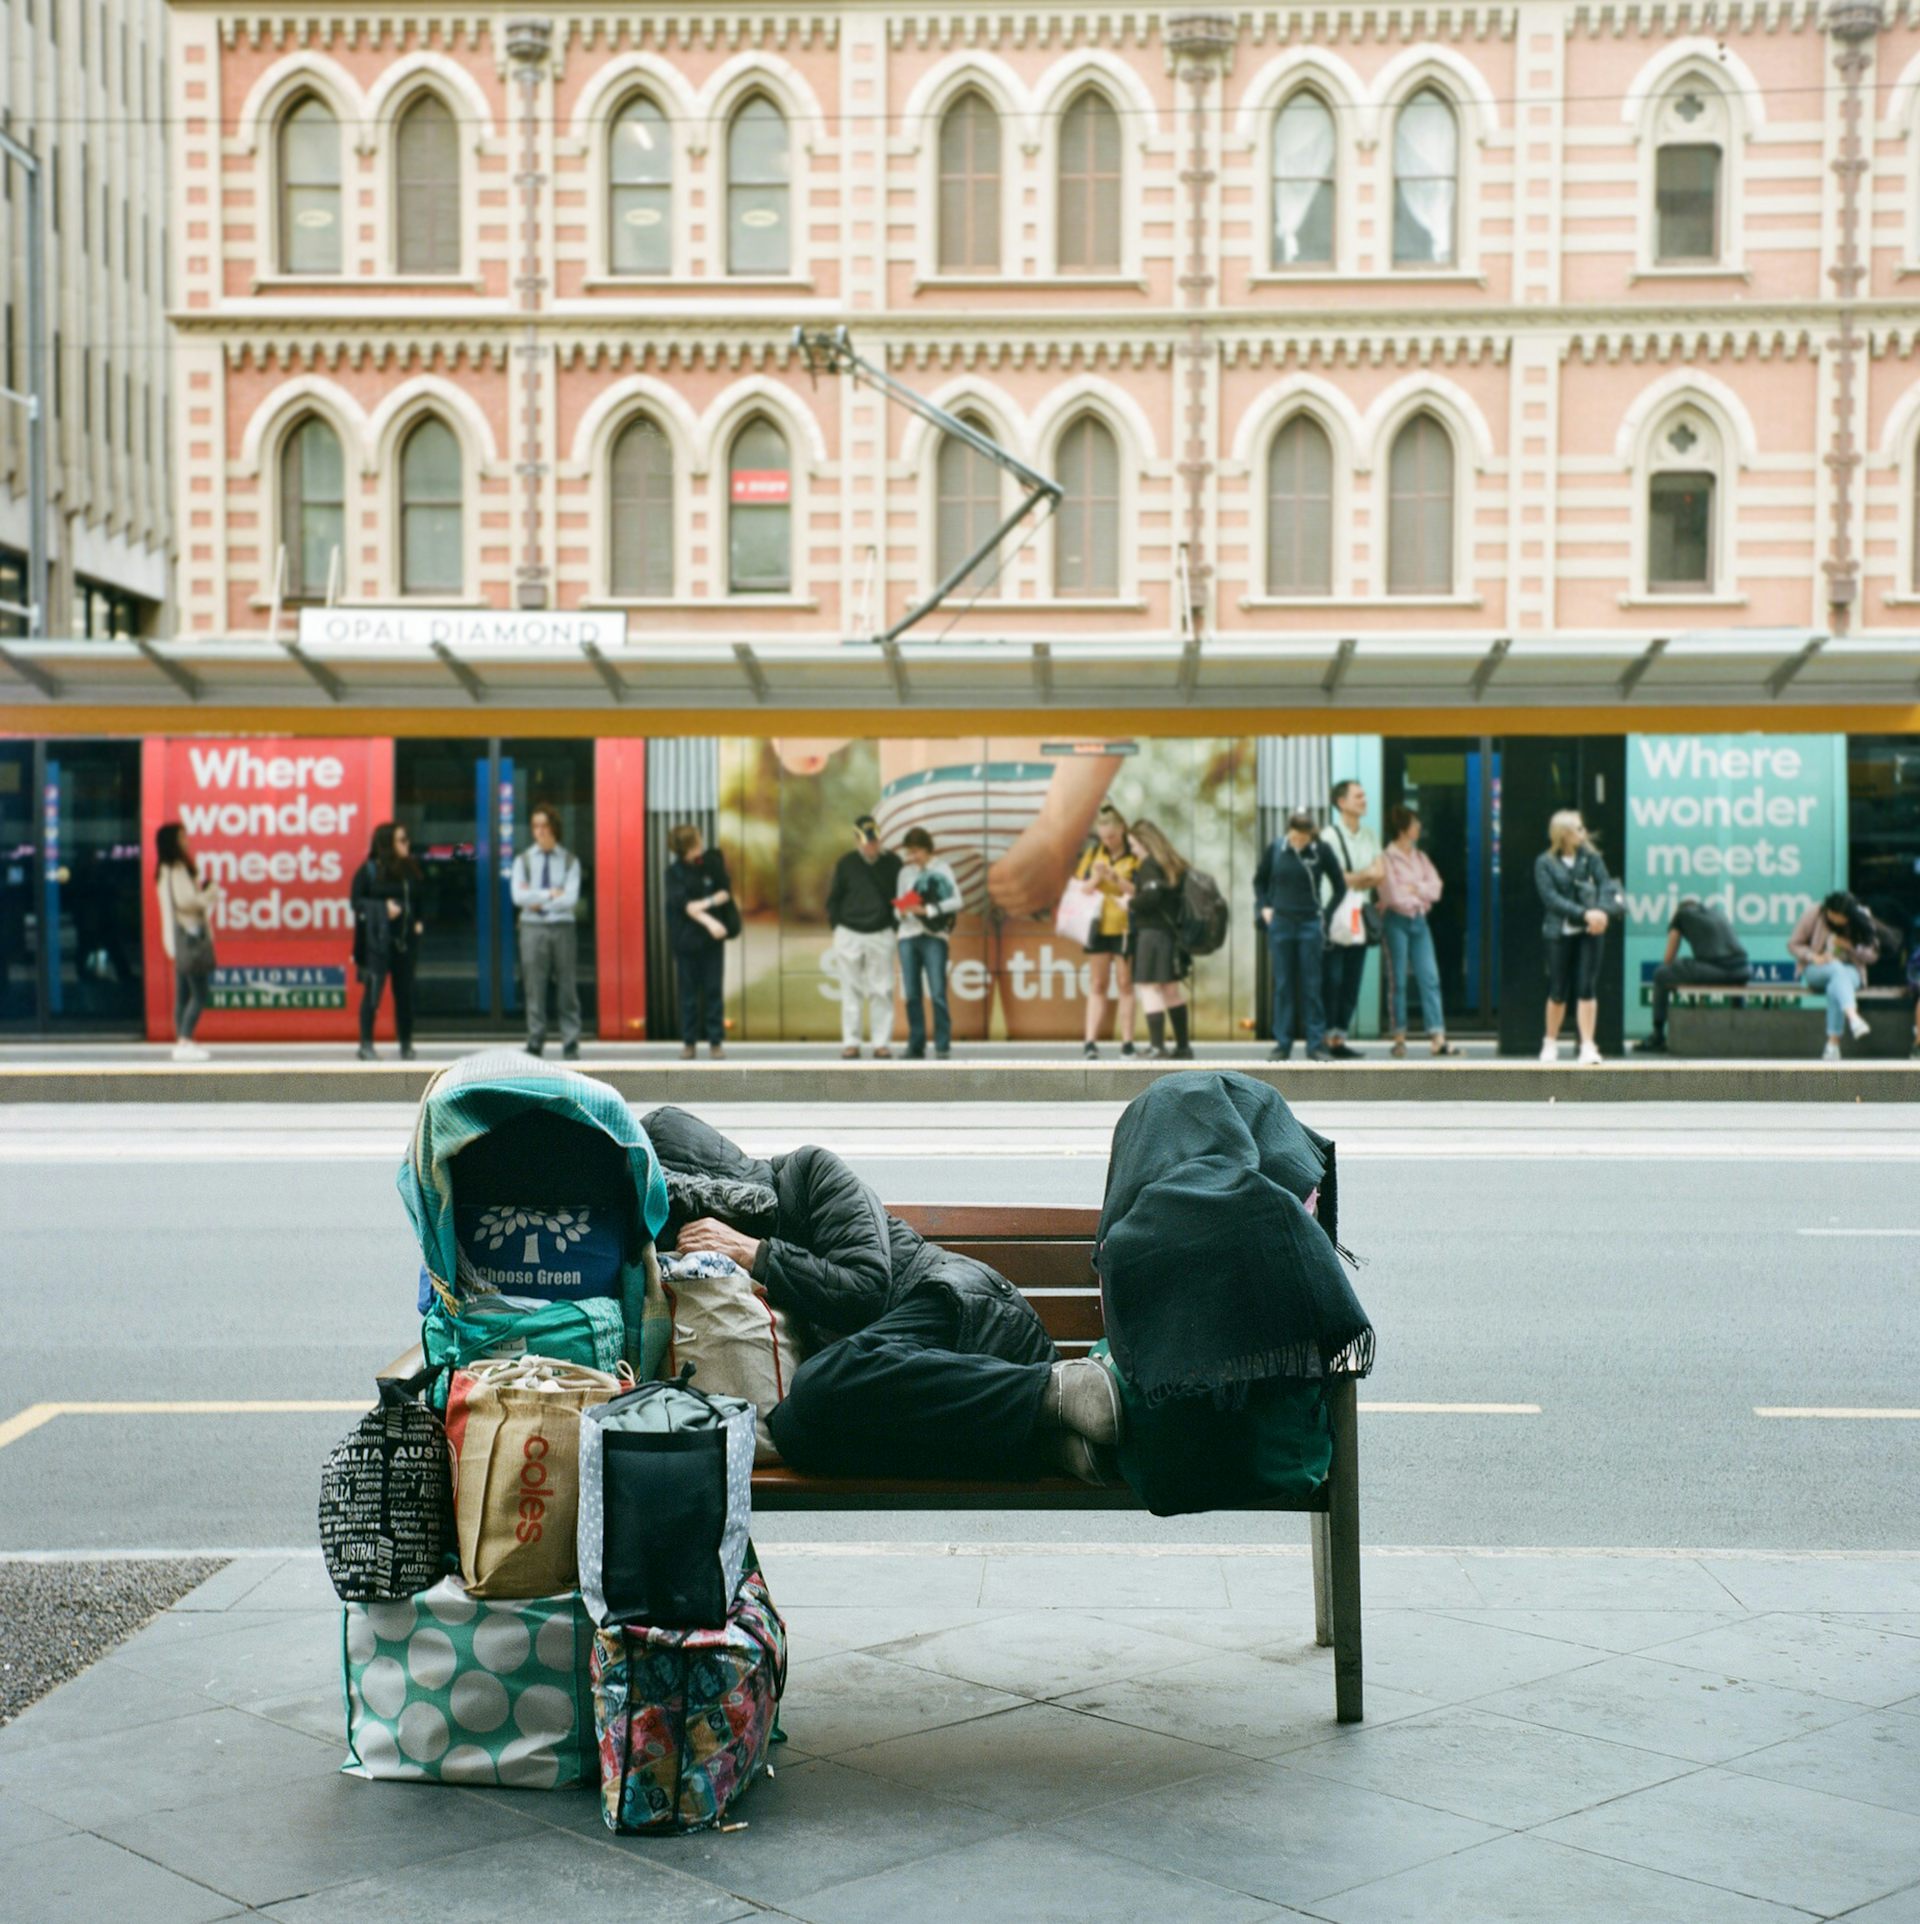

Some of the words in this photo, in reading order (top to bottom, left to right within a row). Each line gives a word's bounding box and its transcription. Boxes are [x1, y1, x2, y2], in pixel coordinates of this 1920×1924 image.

[325, 617, 415, 643] OPAL
[431, 617, 602, 645] DIAMOND
[189, 747, 345, 789] Where
[1640, 735, 1802, 779] Where
[178, 794, 357, 837] wonder
[1630, 787, 1818, 828] wonder
[196, 846, 342, 883] meets
[1646, 838, 1802, 876] meets
[209, 888, 356, 930] isdom
[1627, 883, 1812, 924] widom
[213, 969, 327, 984] NATIONAL
[211, 992, 342, 1007] HARMACIES
[478, 1265, 534, 1284] Choose
[537, 1268, 582, 1286] Green
[515, 1435, 554, 1543] coles
[340, 1542, 377, 1561] AUSTRAL
